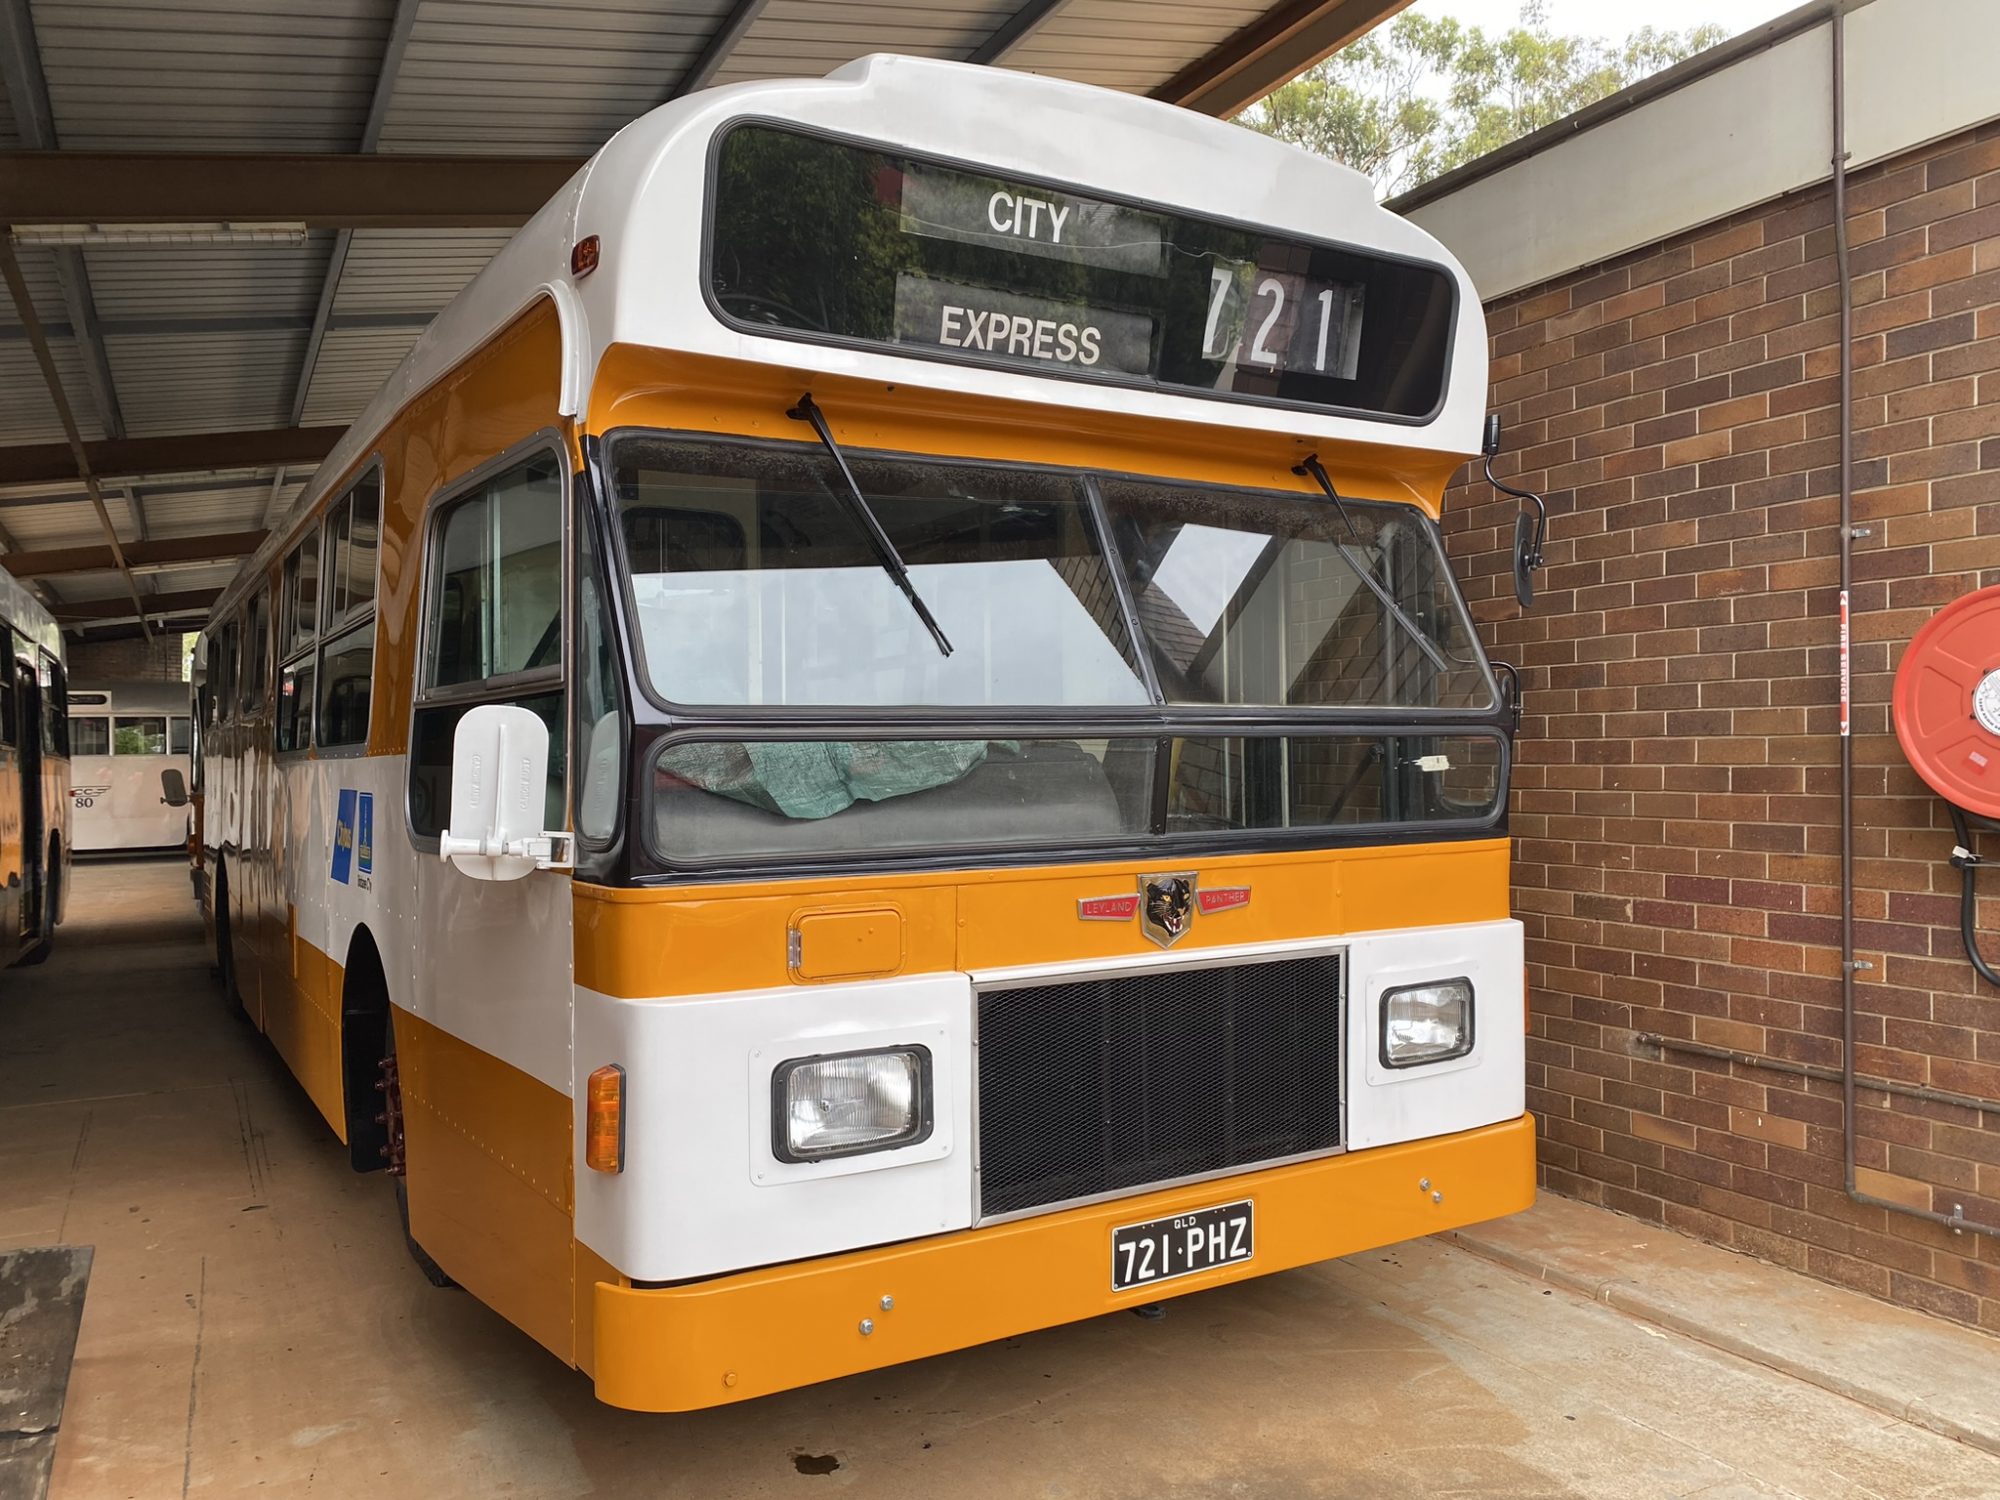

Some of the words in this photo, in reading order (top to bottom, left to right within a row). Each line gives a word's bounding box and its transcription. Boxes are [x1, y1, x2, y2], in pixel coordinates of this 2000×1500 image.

[988, 191, 1070, 244] CITY
[939, 305, 1101, 365] EXPRESS
[1202, 267, 1333, 371] 721
[75, 797, 93, 808] 80
[1086, 901, 1132, 914] LEYLAND
[1205, 891, 1246, 904] PANTHER
[1174, 1216, 1197, 1230] QLD
